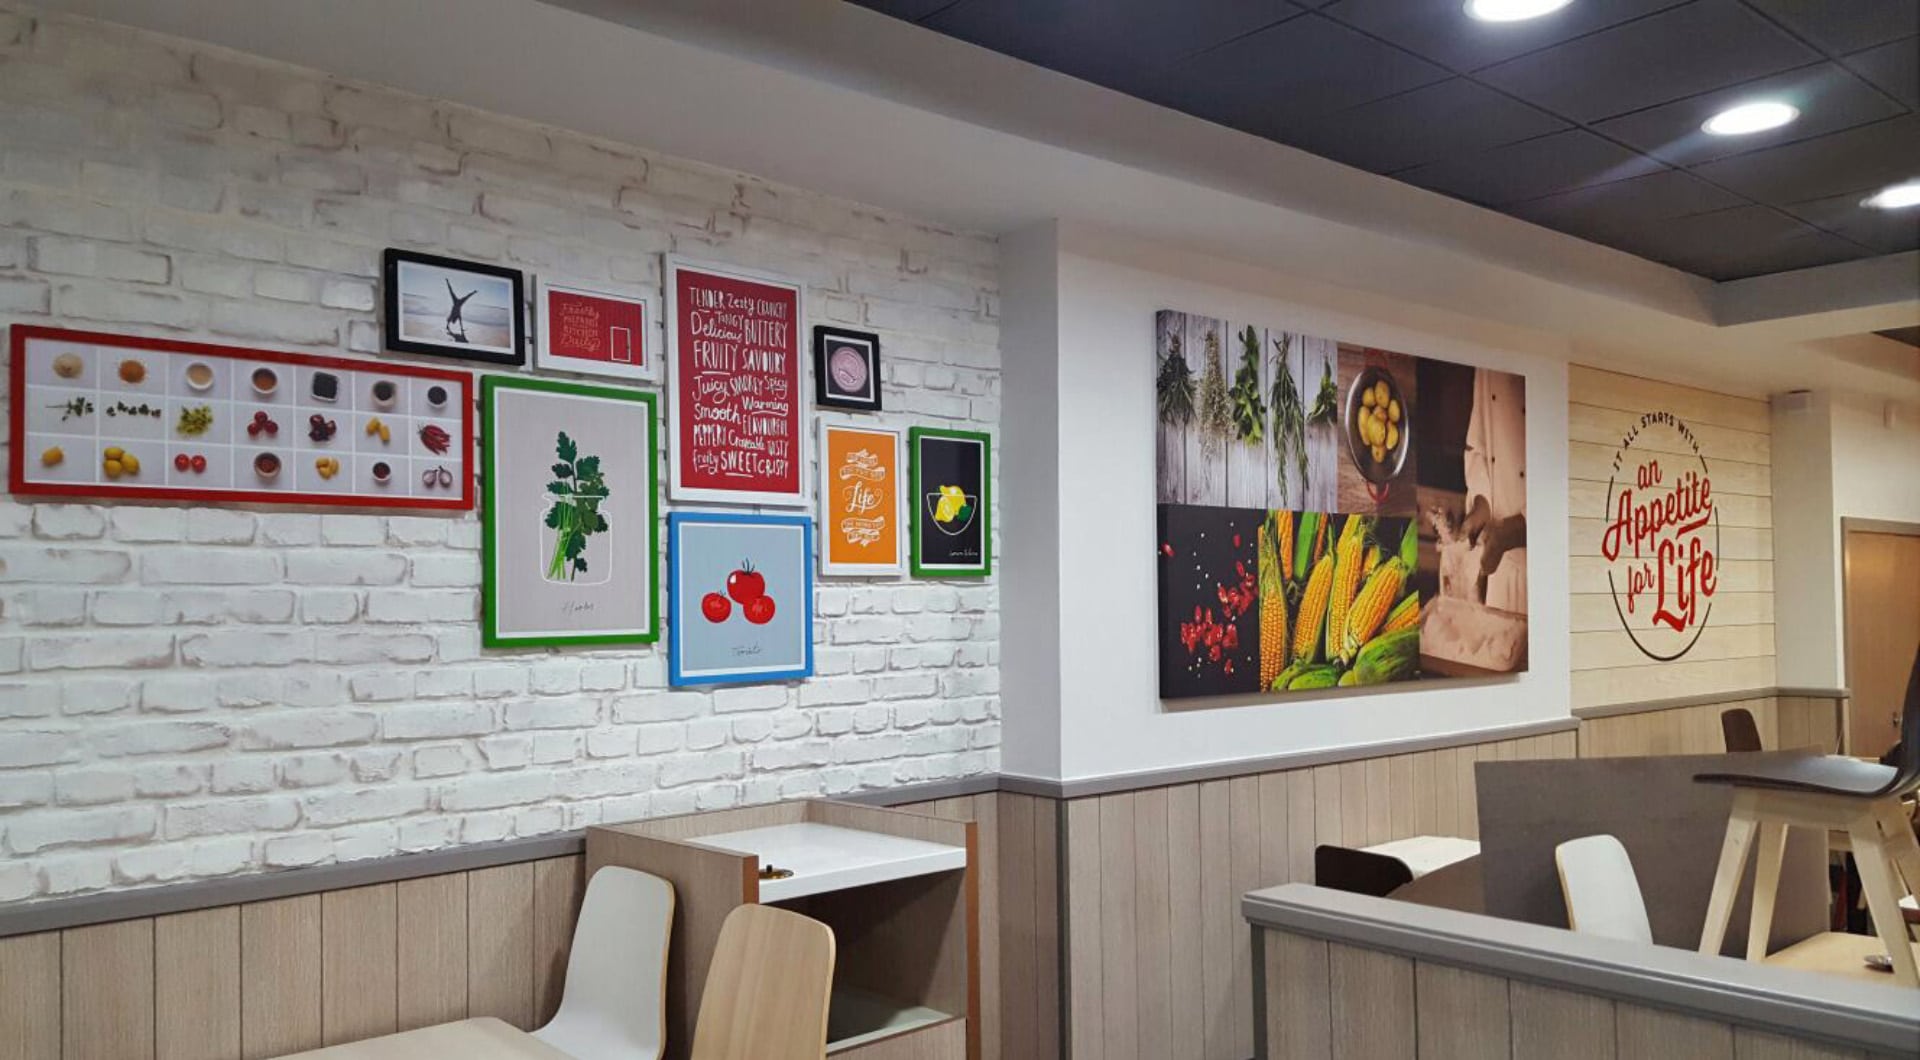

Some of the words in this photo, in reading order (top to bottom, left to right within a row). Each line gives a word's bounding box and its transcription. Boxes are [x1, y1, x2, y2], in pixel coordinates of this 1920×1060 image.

[689, 286, 726, 309] TENDER
[727, 293, 754, 316] Zesty
[757, 298, 788, 320] CRUNCHY
[691, 311, 743, 342] Delicious
[744, 319, 788, 349] BUTTERY
[693, 340, 738, 371] FRUITY
[742, 348, 786, 375] SAVOURY
[692, 376, 730, 404] Juicy
[764, 375, 788, 400] Spicy
[742, 396, 788, 416] Warming
[694, 402, 741, 424] Smooth
[693, 424, 726, 447] PEPPERY
[1623, 424, 1639, 450] ALL
[1640, 411, 1674, 429] STARTS
[1678, 420, 1700, 454] WITH
[720, 450, 758, 473] SWEET
[757, 458, 789, 479] CRISPY
[1637, 459, 1663, 490] an
[843, 481, 884, 514] Life
[1601, 471, 1713, 562] Appetite
[1627, 562, 1655, 614] for
[1652, 536, 1718, 632] Life
